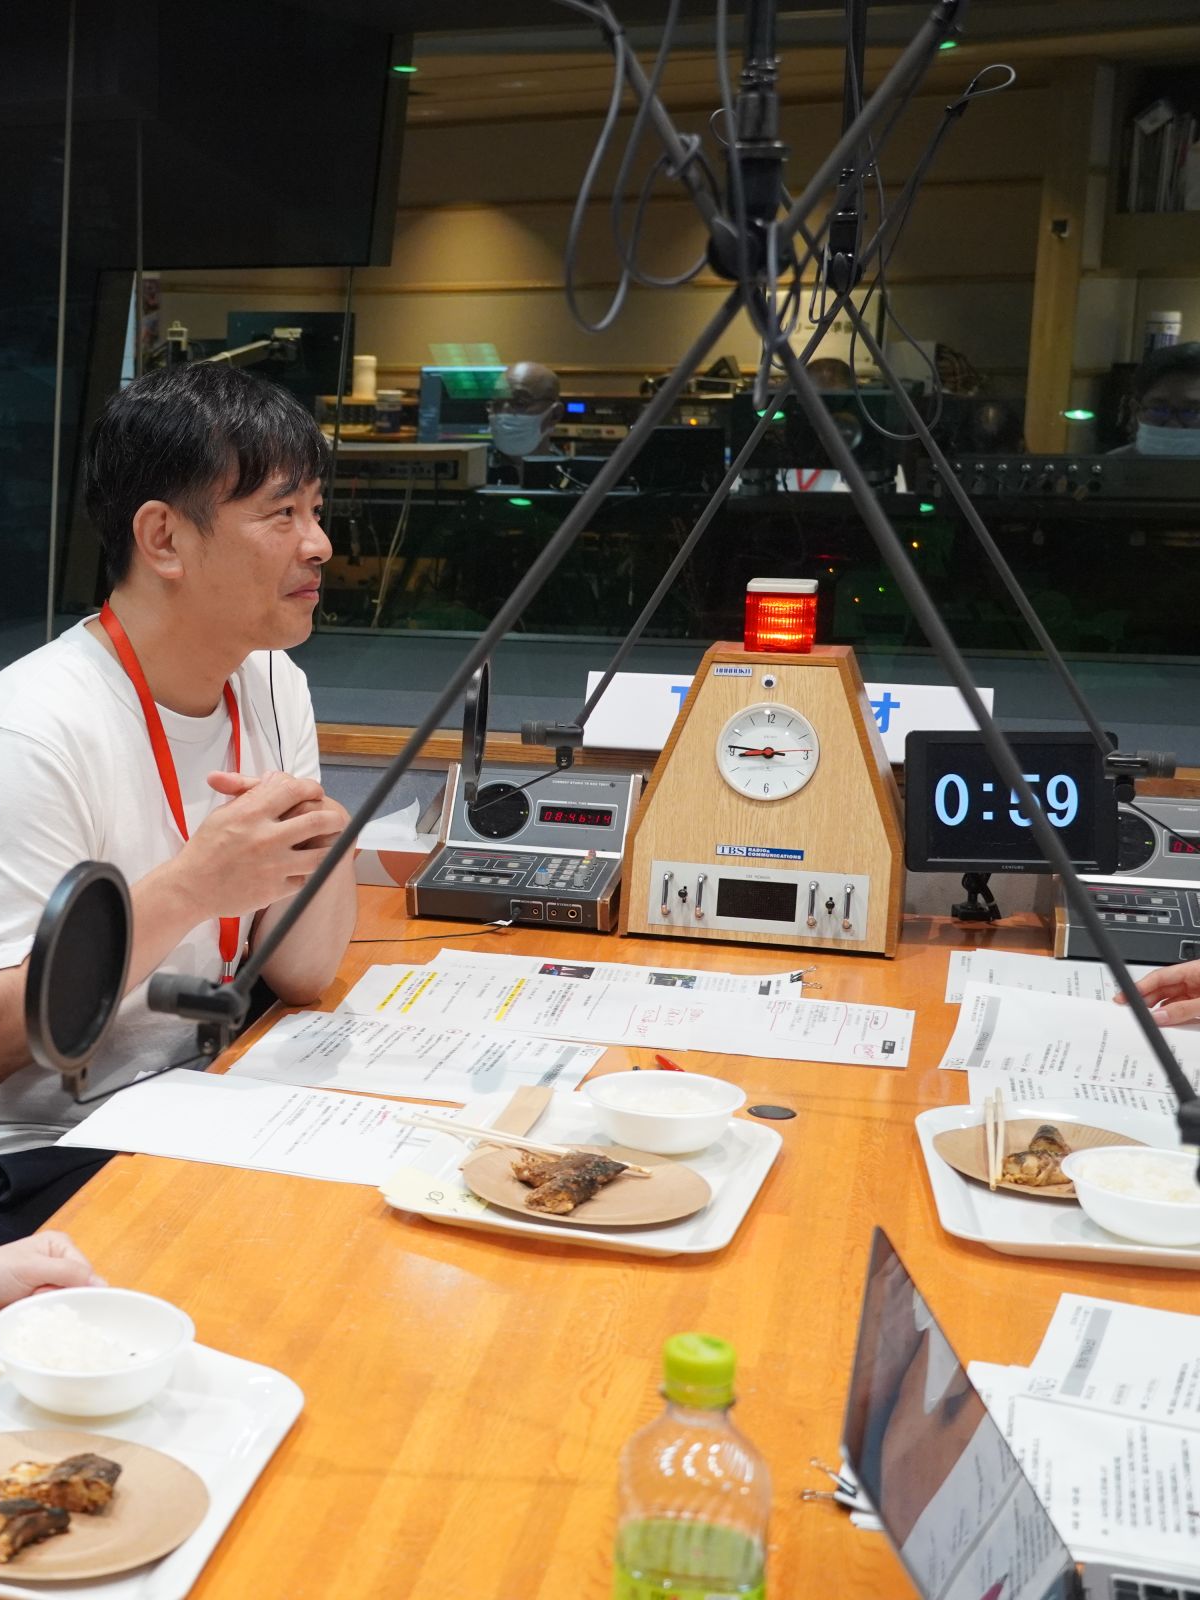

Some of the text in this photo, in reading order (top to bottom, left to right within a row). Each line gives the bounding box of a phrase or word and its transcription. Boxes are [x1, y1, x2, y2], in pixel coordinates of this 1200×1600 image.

[767, 713, 776, 724] 12
[763, 782, 770, 794] 6
[934, 773, 1079, 828] 0:59
[720, 845, 745, 855] TBS
[747, 851, 802, 860] COMMUNICATIONS
